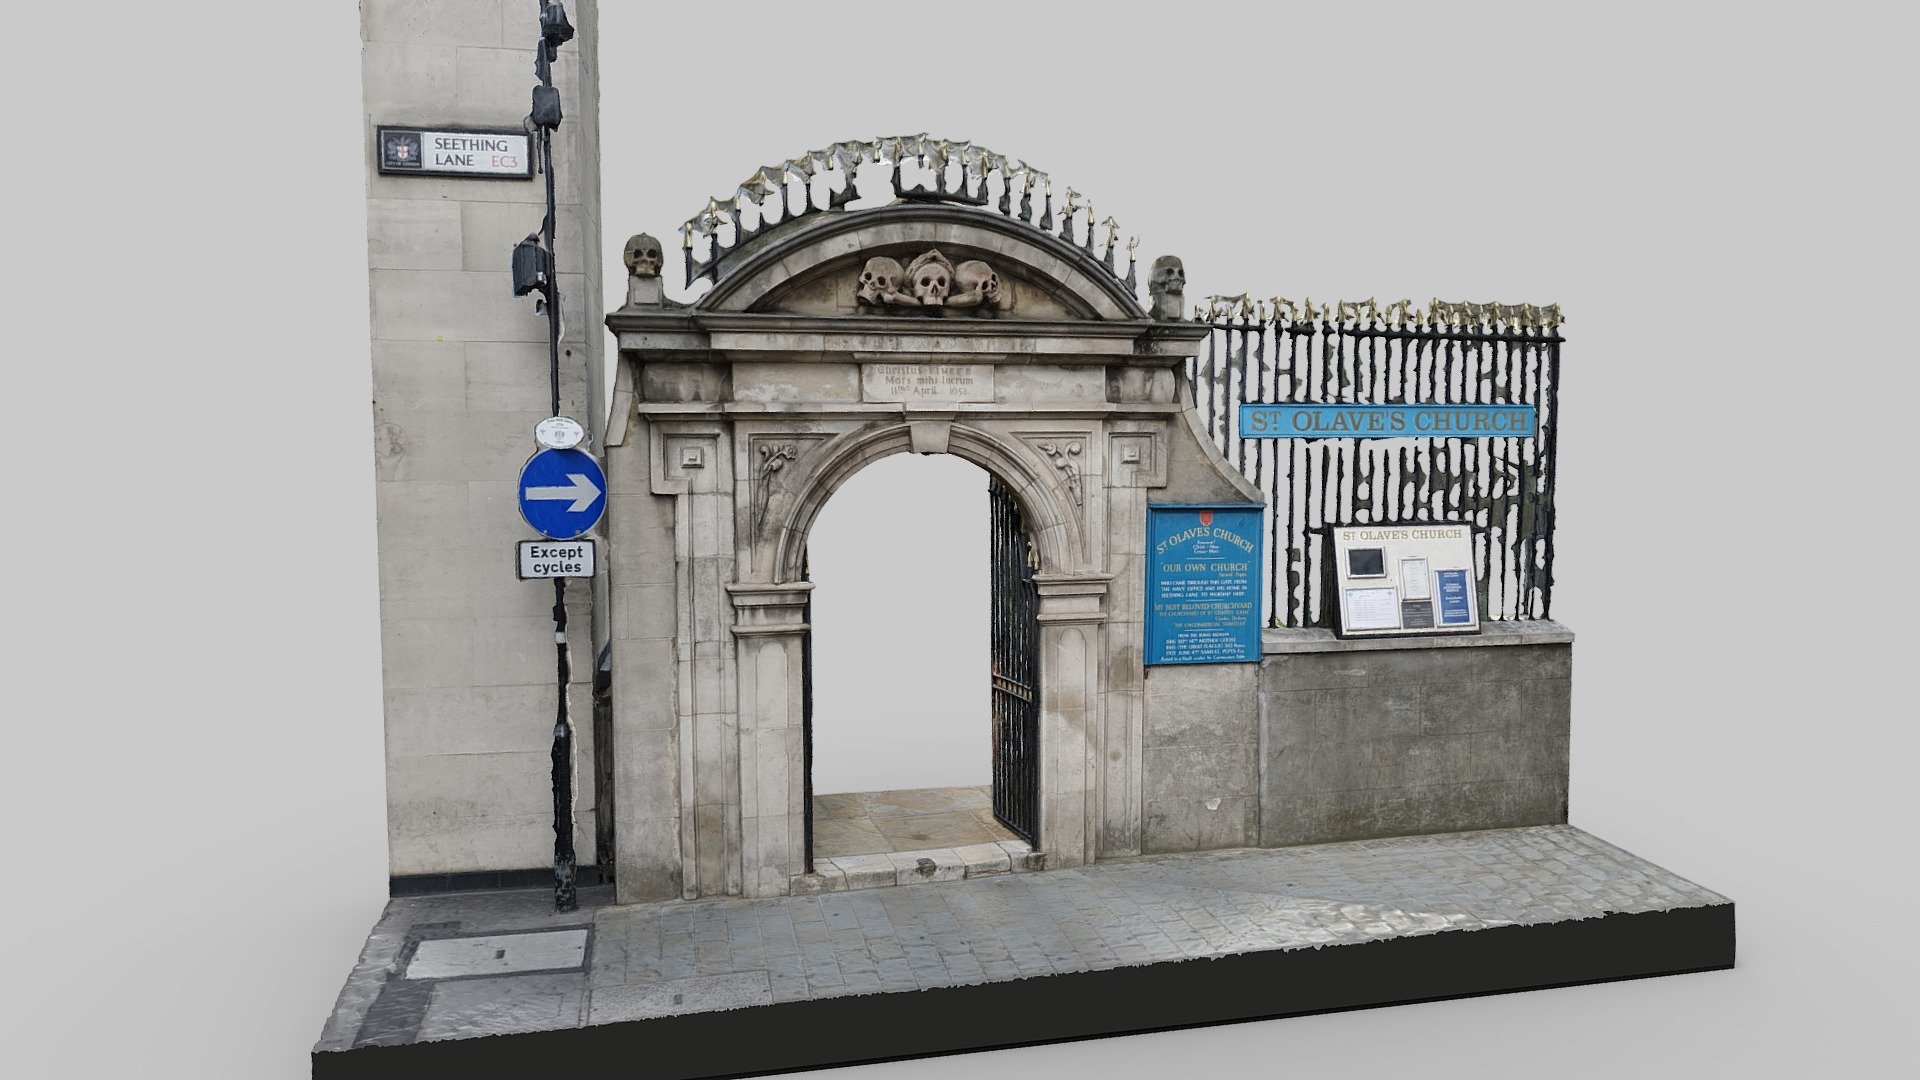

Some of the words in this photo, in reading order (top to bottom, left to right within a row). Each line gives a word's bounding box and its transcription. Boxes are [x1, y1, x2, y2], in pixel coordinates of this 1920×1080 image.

[434, 138, 507, 152] SEETHING
[435, 154, 474, 166] LANE
[491, 156, 518, 168] EC3
[1291, 410, 1405, 432] OLAVE'S
[1414, 410, 1528, 432] CHURCH
[1213, 527, 1254, 553] CHURCH
[1360, 530, 1408, 540] OLAVE'S
[1412, 529, 1463, 540] CHURCH
[530, 545, 583, 560] Except
[533, 561, 582, 575] cycles
[1185, 563, 1207, 572] OWN
